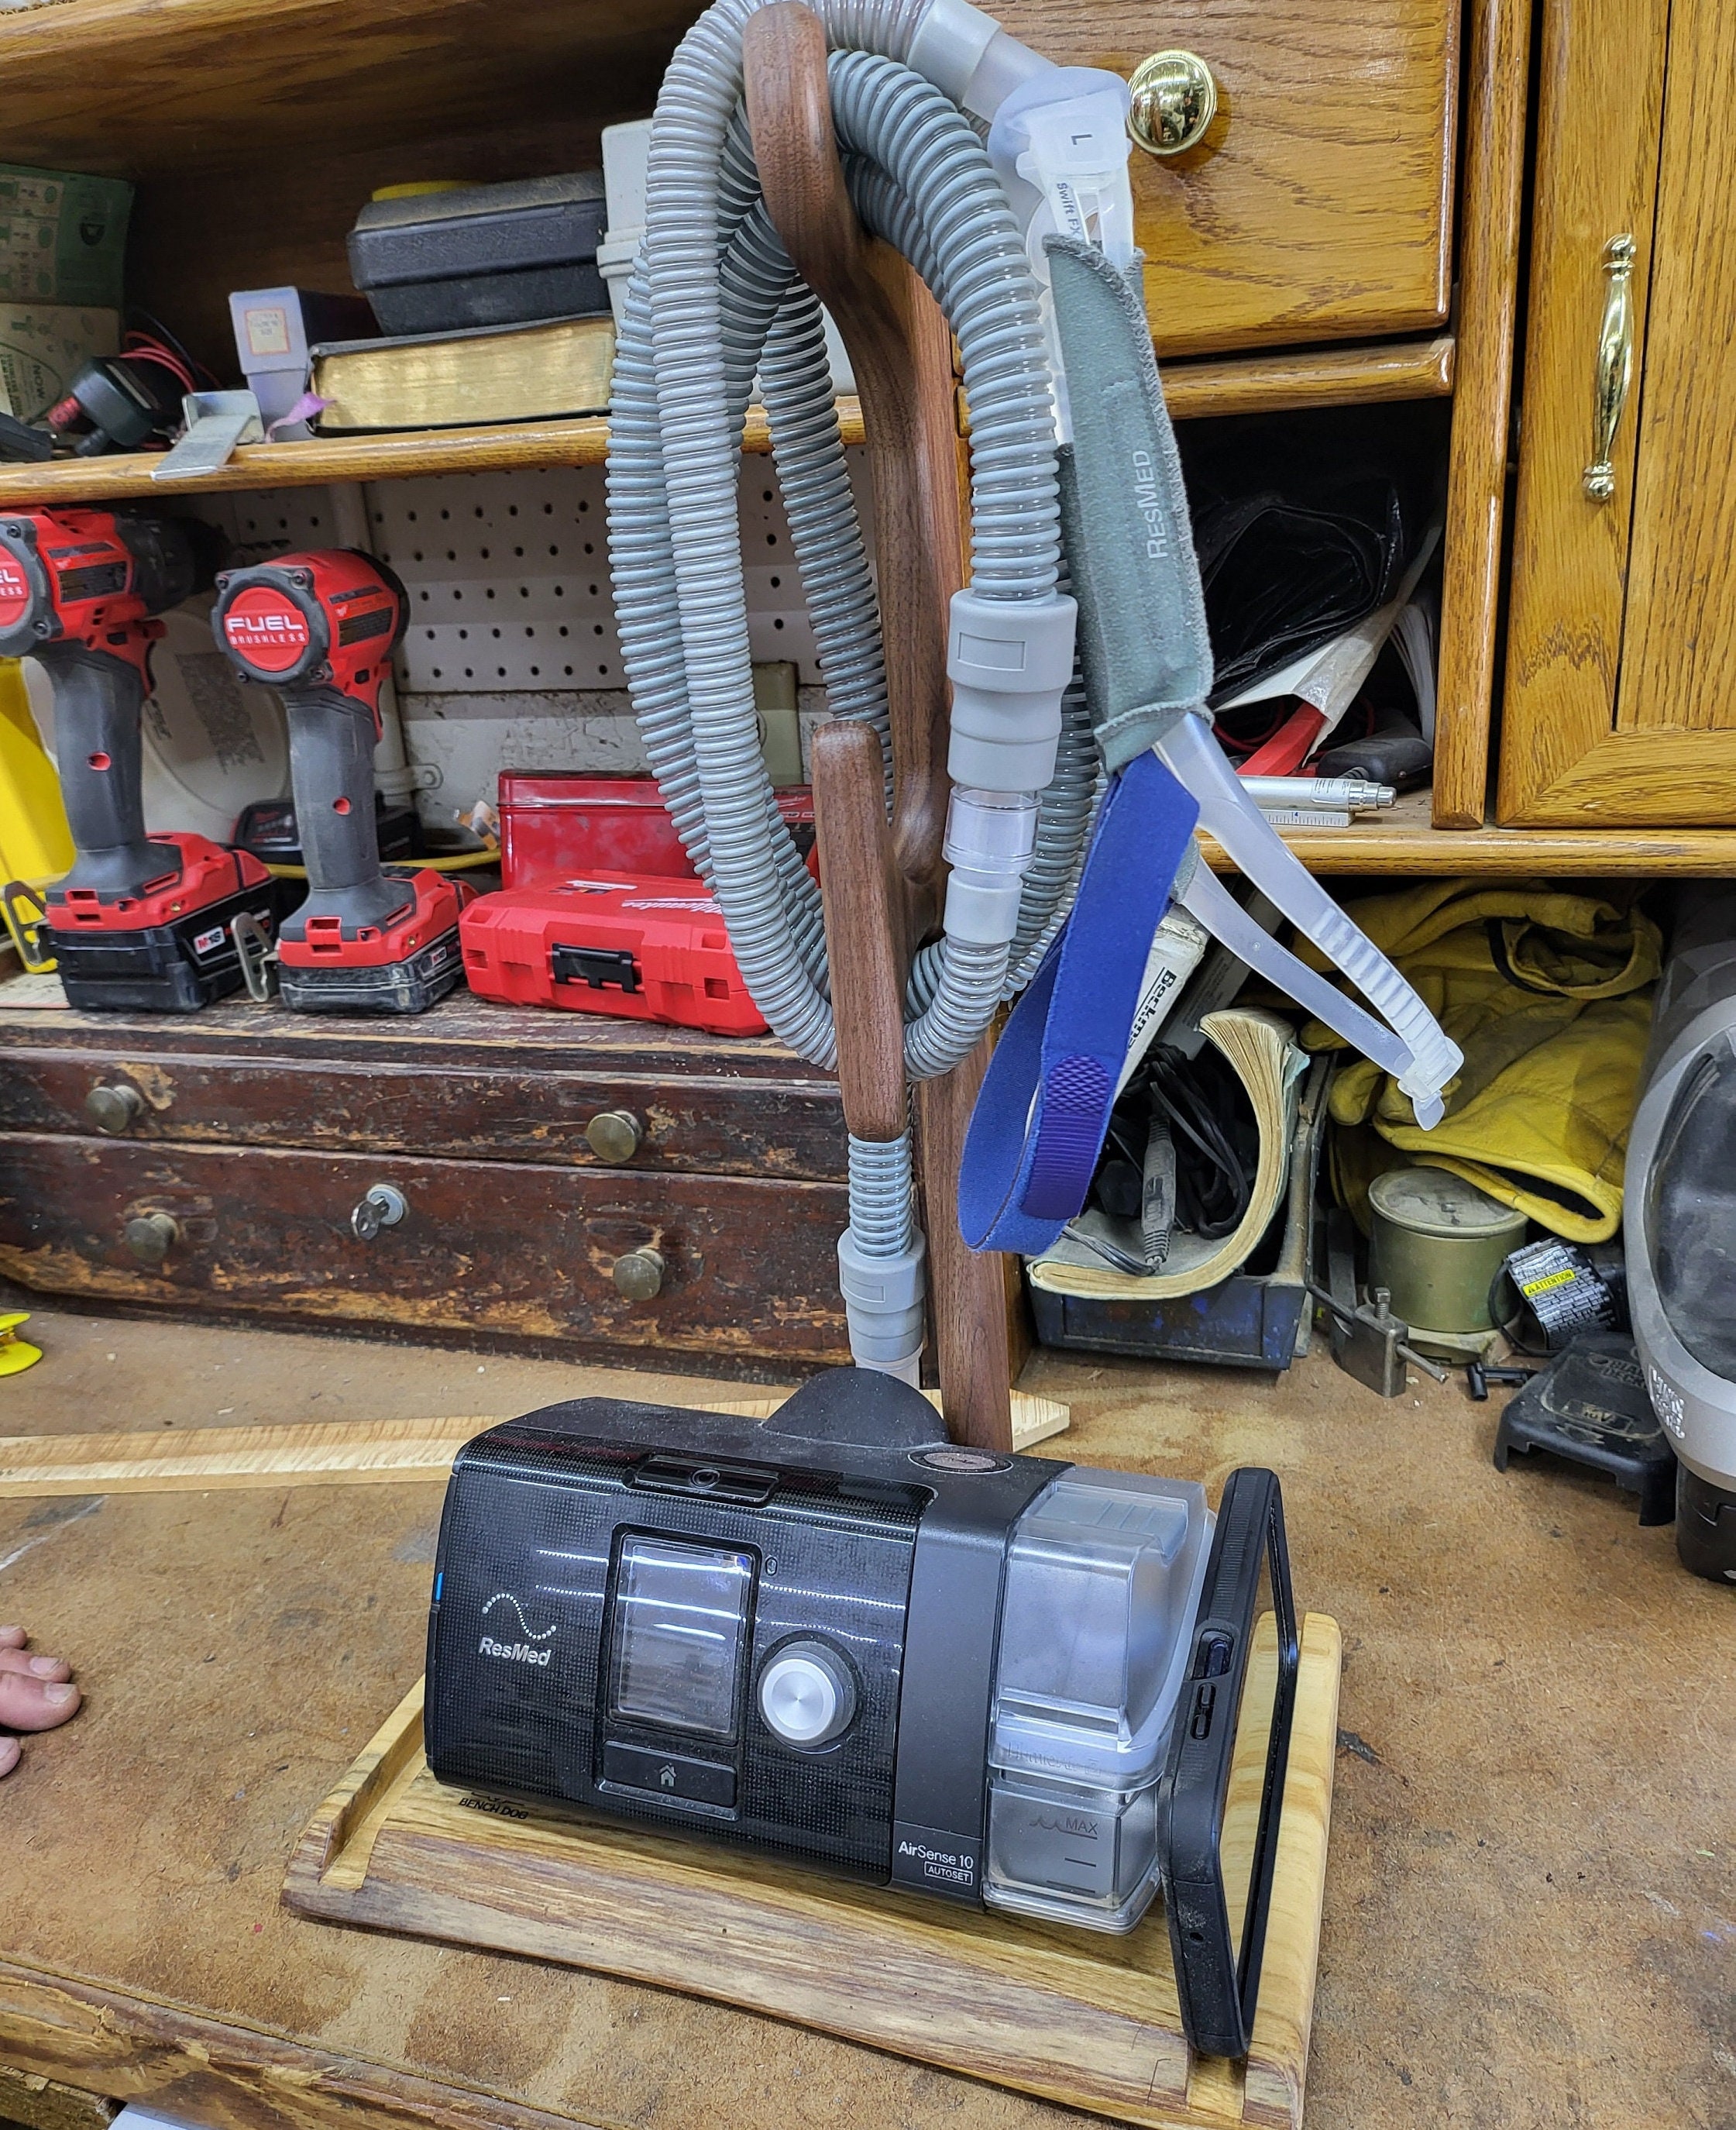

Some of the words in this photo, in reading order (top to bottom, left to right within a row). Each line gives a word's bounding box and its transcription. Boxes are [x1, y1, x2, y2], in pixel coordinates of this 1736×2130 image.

[1071, 134, 1093, 146] L
[1057, 182, 1076, 215] Swift
[1133, 450, 1169, 559] RESMED
[227, 614, 304, 633] FUEL
[229, 632, 306, 645] BRUSHLESS
[1128, 969, 1177, 1050] Beckma
[1535, 1271, 1573, 1291] ATTENTION
[478, 1636, 552, 1667] ResMed
[458, 1797, 500, 1814] BENCH
[500, 1805, 529, 1820] DOG
[1065, 1817, 1099, 1836] MAX
[898, 1840, 957, 1866] AirSense
[959, 1854, 975, 1870] 10
[927, 1865, 971, 1883] AUTOSET
